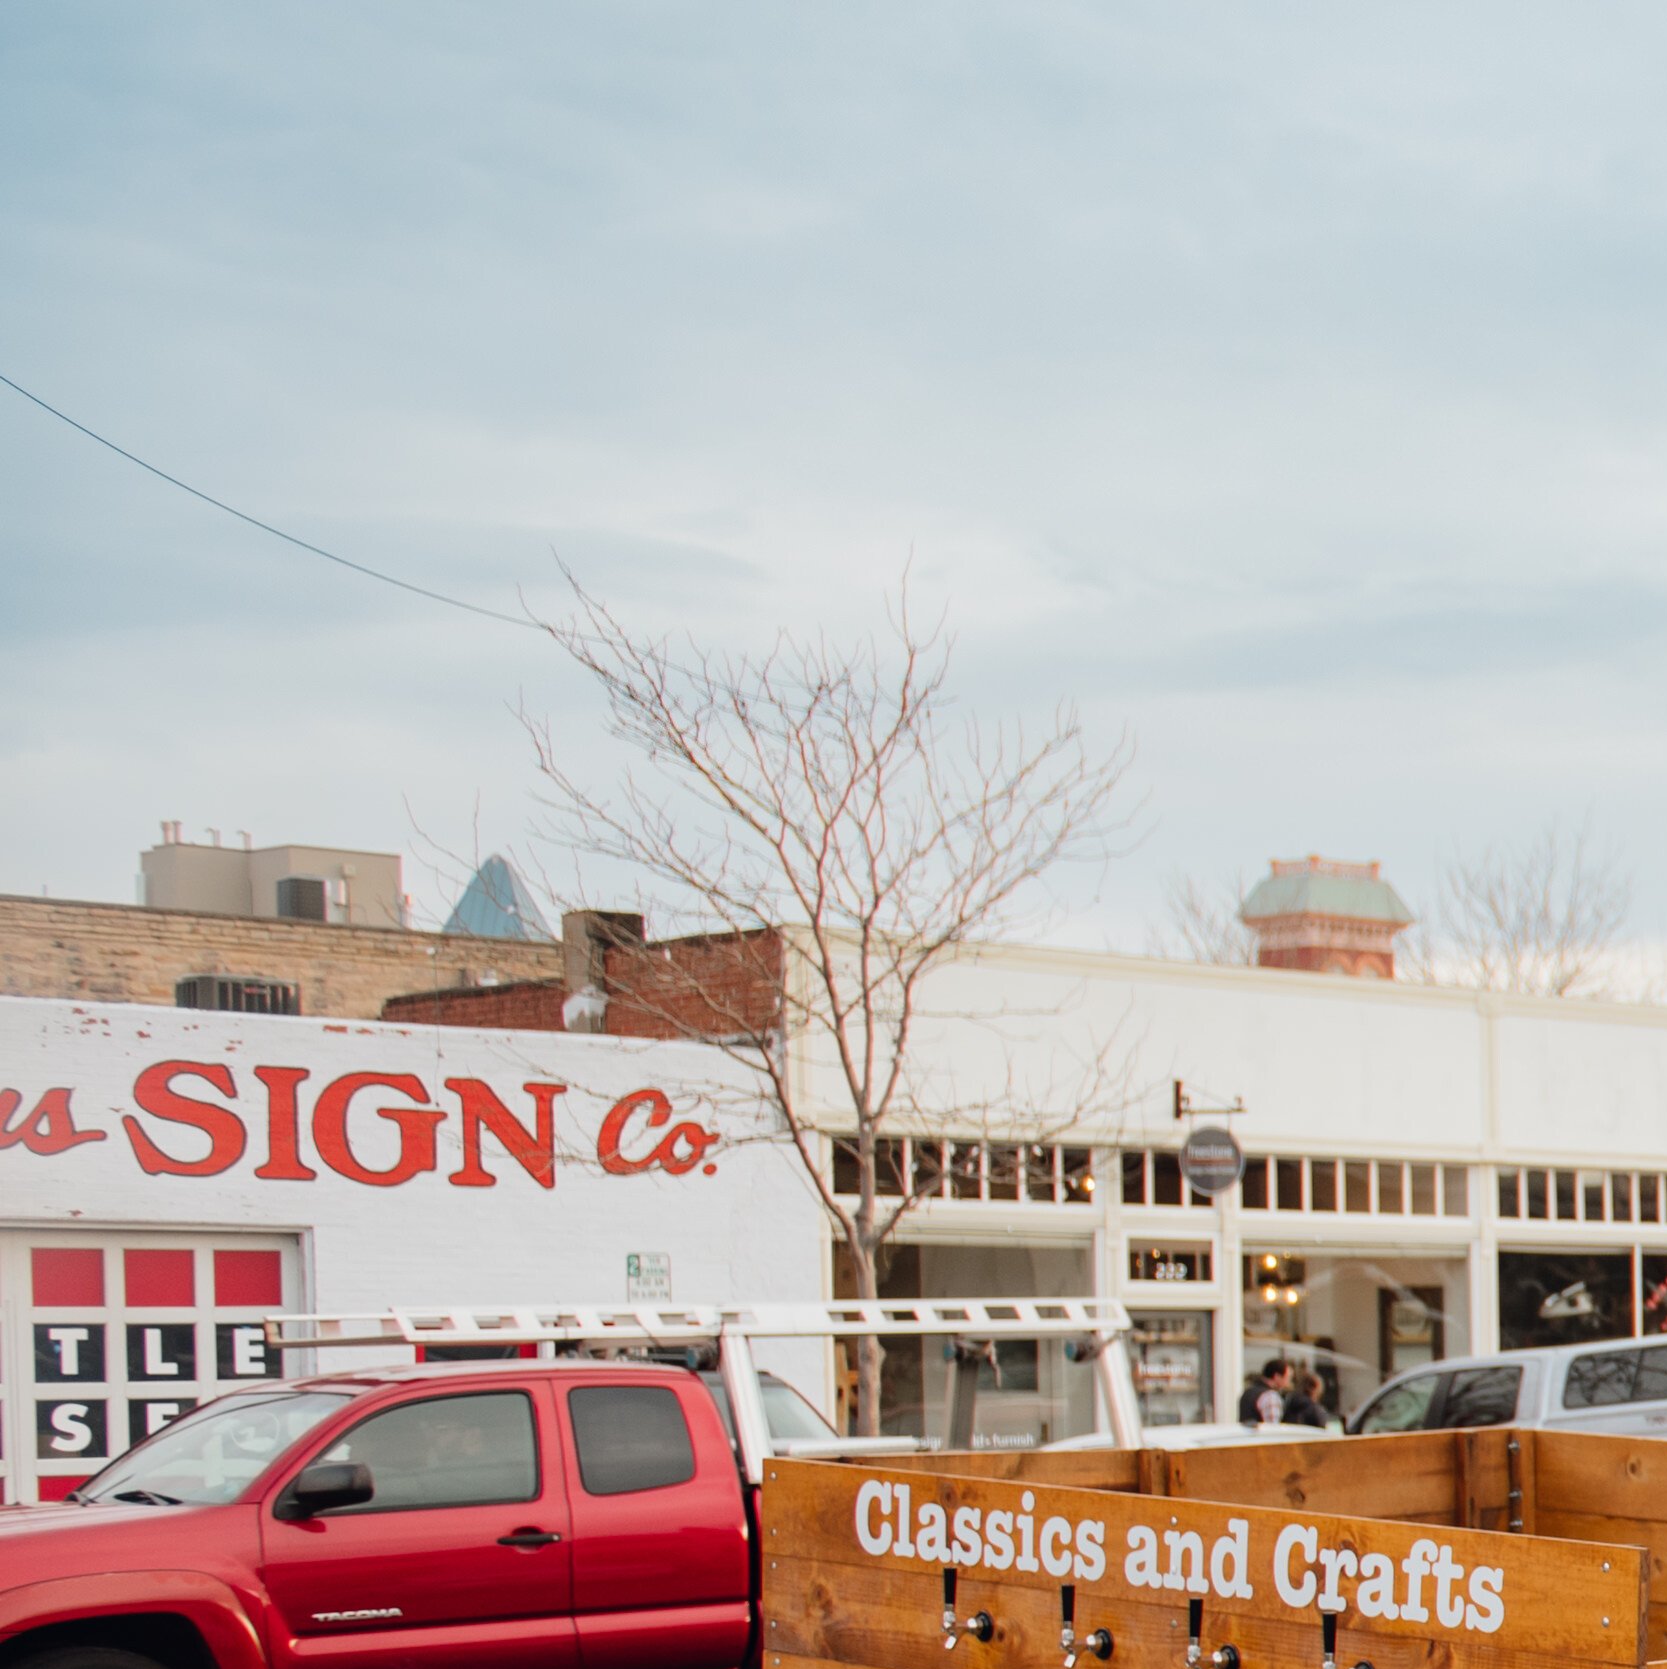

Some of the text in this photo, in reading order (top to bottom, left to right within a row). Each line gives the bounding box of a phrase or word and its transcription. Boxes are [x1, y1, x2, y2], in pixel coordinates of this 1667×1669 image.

[121, 1059, 569, 1190] SIGN
[598, 1087, 720, 1177] Co.
[311, 1607, 404, 1622] TACOMA
[854, 1479, 1505, 1633] Classics and Crafts
